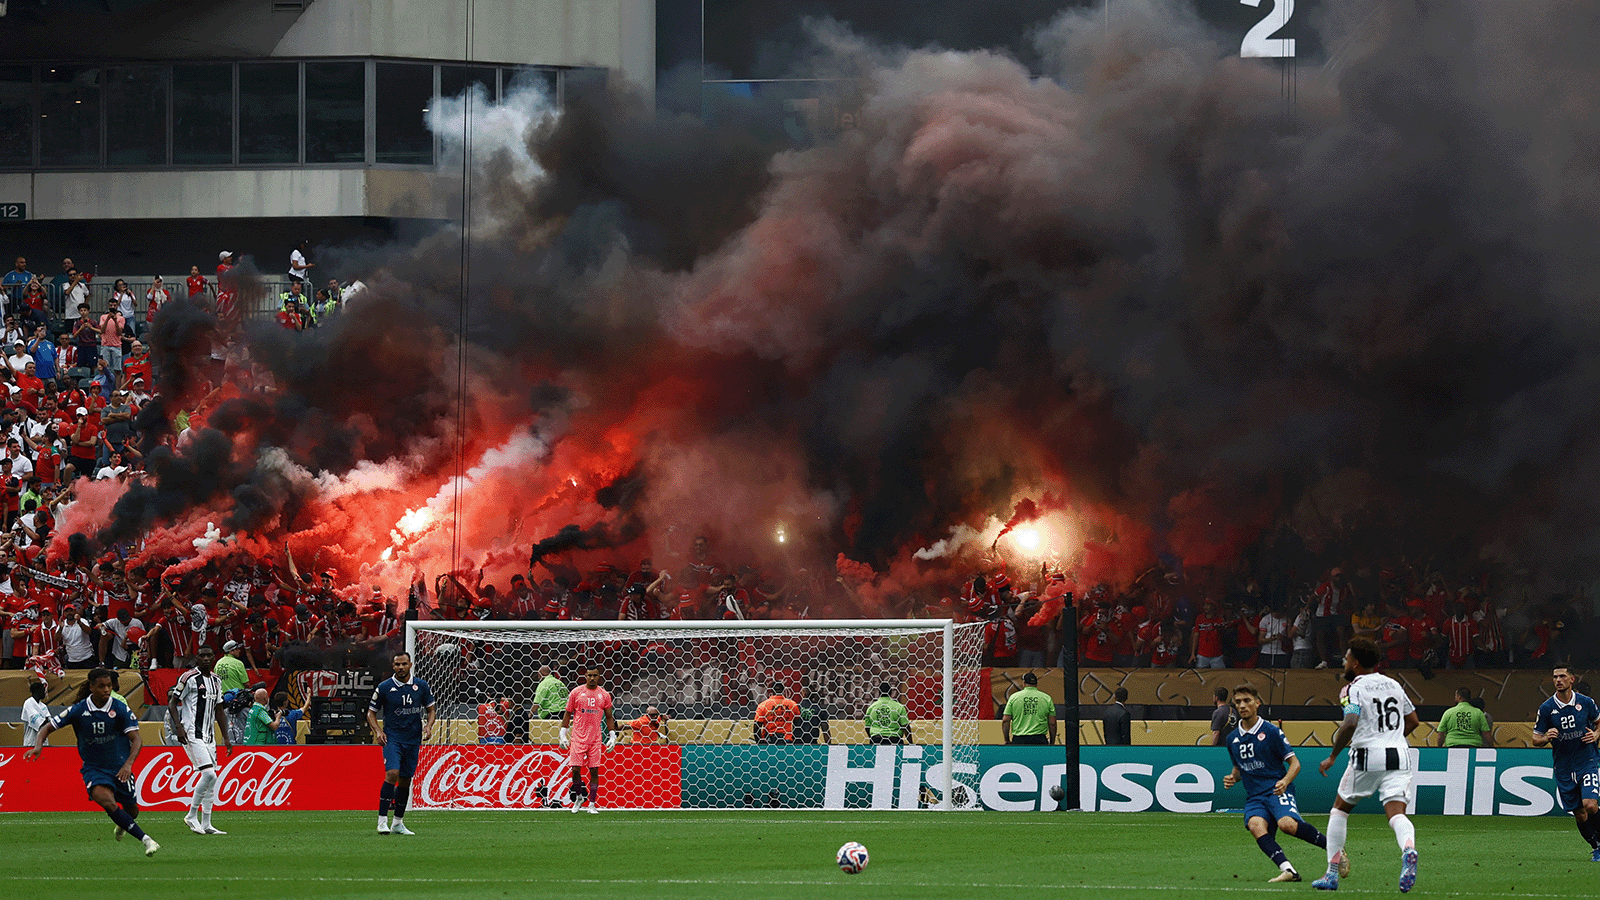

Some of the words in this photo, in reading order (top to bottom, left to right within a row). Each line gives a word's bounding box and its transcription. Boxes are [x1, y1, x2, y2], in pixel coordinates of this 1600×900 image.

[0, 205, 19, 218] 12
[401, 694, 413, 706] 14
[587, 697, 596, 707] 12
[1372, 696, 1400, 733] 16
[1560, 714, 1576, 730] 22
[91, 721, 106, 734] 19
[1239, 743, 1255, 760] 23
[824, 745, 1214, 813] Hisense
[1582, 772, 1599, 788] 22
